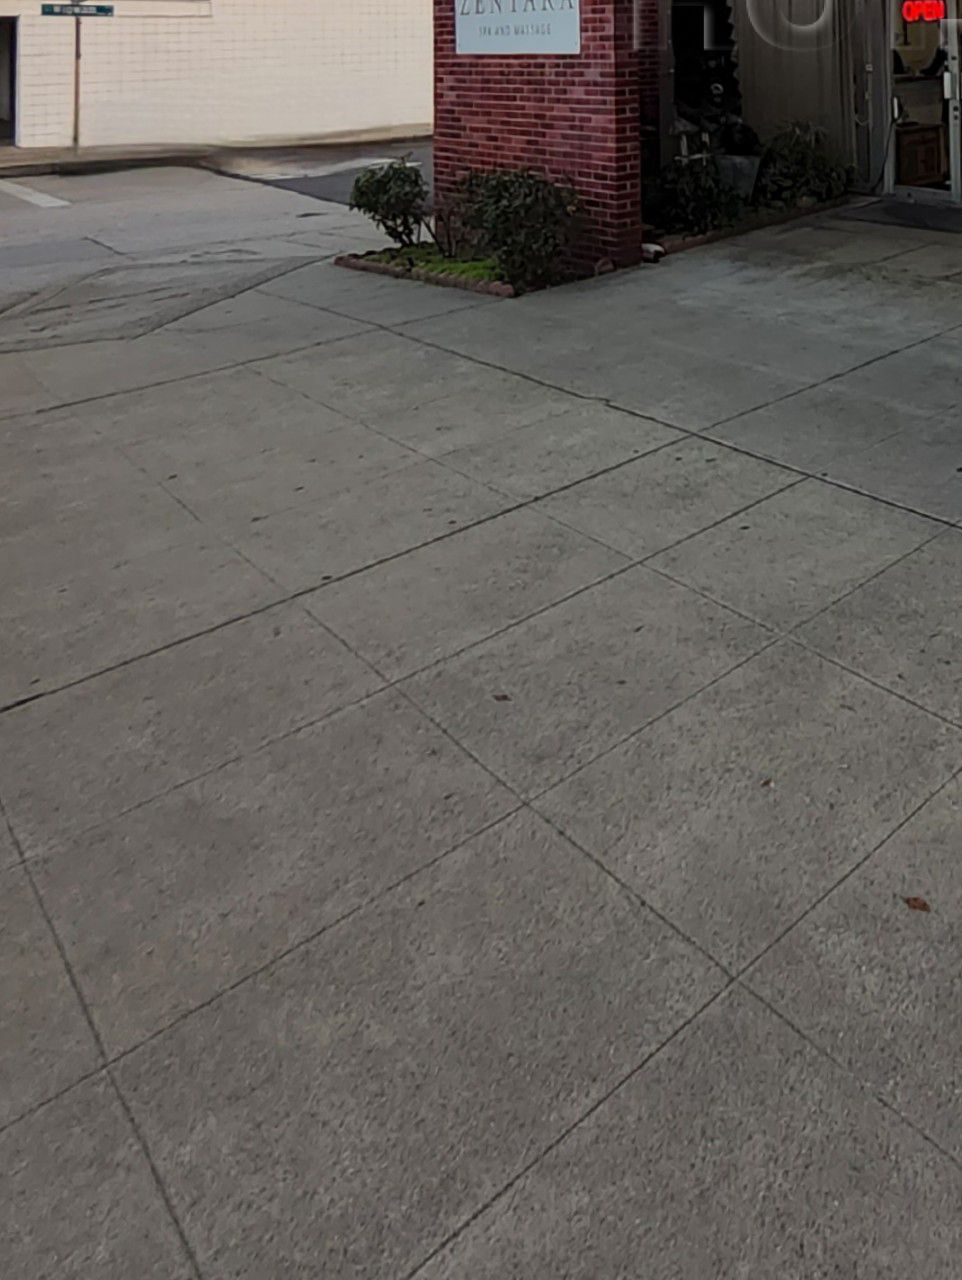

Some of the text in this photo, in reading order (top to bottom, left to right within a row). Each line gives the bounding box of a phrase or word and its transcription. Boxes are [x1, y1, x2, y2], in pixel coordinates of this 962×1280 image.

[902, 0, 945, 22] OPEN
[478, 22, 551, 37] SPA AND MASSAGE
